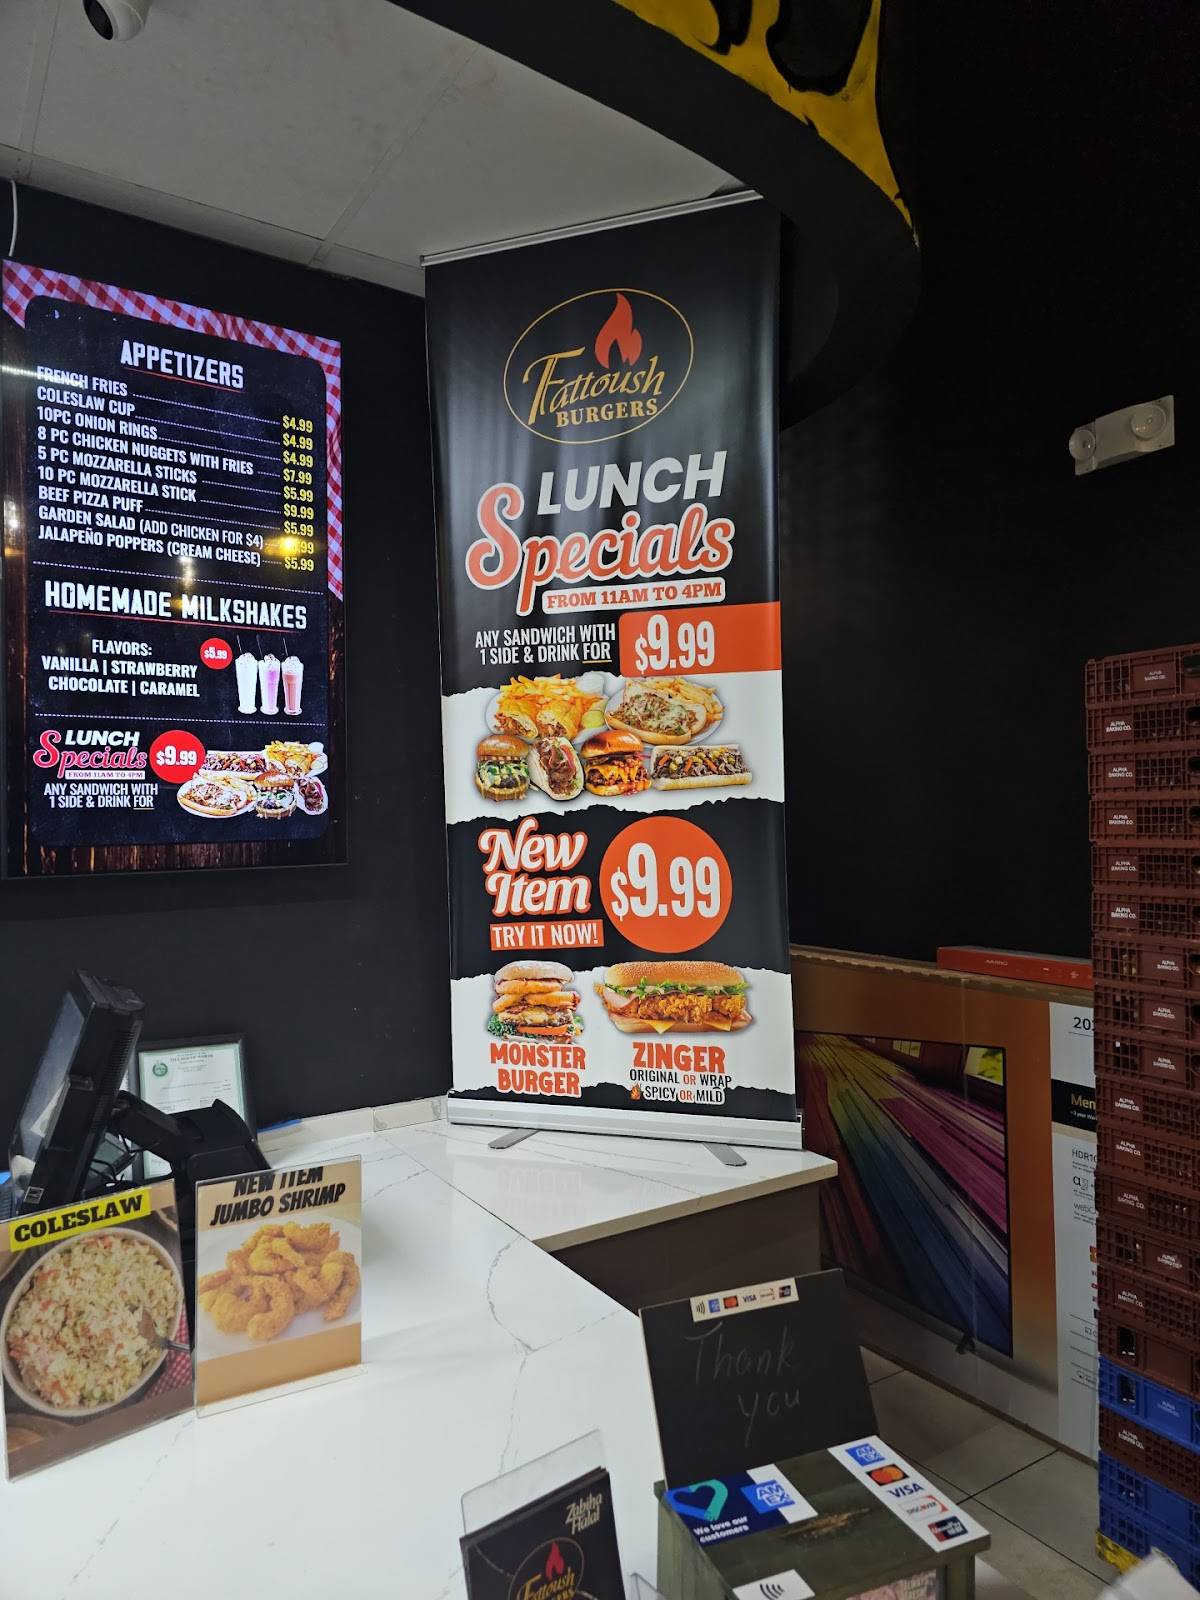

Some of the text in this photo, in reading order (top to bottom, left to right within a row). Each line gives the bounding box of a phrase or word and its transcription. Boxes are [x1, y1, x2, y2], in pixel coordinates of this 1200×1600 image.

[120, 340, 244, 389] APPETIZERS
[37, 366, 313, 434] FRENCH FRIES $4.99
[522, 346, 667, 425] Fattoush
[37, 387, 313, 451] COLESLAW CUP $4.99
[556, 398, 658, 428] BURGERS
[37, 406, 313, 468] 10PC ONION RINGS $4.99
[37, 426, 312, 485] 8 PC CHICKEN NUGGETS WITH FRIES $7.99
[38, 446, 313, 503] 5 PC MOZZARELLA STICKS $5.99
[537, 450, 728, 516] LUNCH
[37, 465, 314, 521] 10 PC MOZZARELLA STICK $9.99
[38, 485, 314, 538] BEEF PIZZA PUFF $5.99
[38, 505, 92, 525] GARDEN
[95, 513, 136, 531] SALAD
[139, 518, 168, 536] (ADD
[171, 521, 219, 542] CHICKEN
[222, 530, 243, 545] FOR
[245, 532, 264, 550] $4)
[38, 525, 314, 573] JALAPEÑO POPPERS (CREAM CHEESE) $5.99
[465, 482, 735, 616] Specials
[45, 580, 307, 629] HOMEMADE MILKSHAKES
[547, 581, 722, 609] FROM 11AM TO 4PM
[92, 639, 152, 657] FLAVORS:
[475, 614, 716, 675] ANY SANDWICH WITH $9.99
[480, 643, 611, 665] 1 SIDE & DRINK FOR
[41, 655, 99, 673] VANILLA
[111, 660, 198, 678] STRAWBERRY
[204, 647, 228, 660] $5.99
[48, 676, 128, 694] CHOCOLATE
[140, 680, 200, 697] CARAMEL
[33, 729, 197, 779] Specials $9.99
[65, 730, 140, 747] LUNCH
[44, 783, 158, 797] ANY SANDWICH WITH
[68, 771, 92, 779] FROM
[126, 771, 144, 779] 4PM
[50, 795, 154, 808] 1 SIDE & DRINK FOR
[478, 816, 589, 873] New
[486, 842, 721, 921] Item $9.99
[492, 923, 599, 948] TRY IT NOW!
[490, 1042, 586, 1070] MONSTER
[632, 1042, 726, 1073] ZINGER
[497, 1068, 581, 1097] BURGER
[629, 1068, 732, 1089] ORIGINAL OR WRAP
[644, 1087, 723, 1103] SPICY OR MILD
[233, 1166, 324, 1198] NEW ITEM
[14, 1194, 144, 1243] COLESLAW
[210, 1182, 346, 1227] JUMBO SHRIMP
[743, 1294, 757, 1303] VISA
[683, 1320, 794, 1385] Thank
[737, 1390, 800, 1449] you
[856, 1444, 876, 1457] AM
[863, 1452, 883, 1463] EX
[756, 1482, 785, 1498] AM
[765, 1493, 791, 1505] EX
[888, 1483, 924, 1498] VISA
[565, 1493, 603, 1525] Zabiha
[572, 1510, 600, 1535] Halal
[906, 1501, 938, 1516] DISCOVER
[693, 1515, 748, 1538] We love our
[699, 1524, 750, 1544] customers
